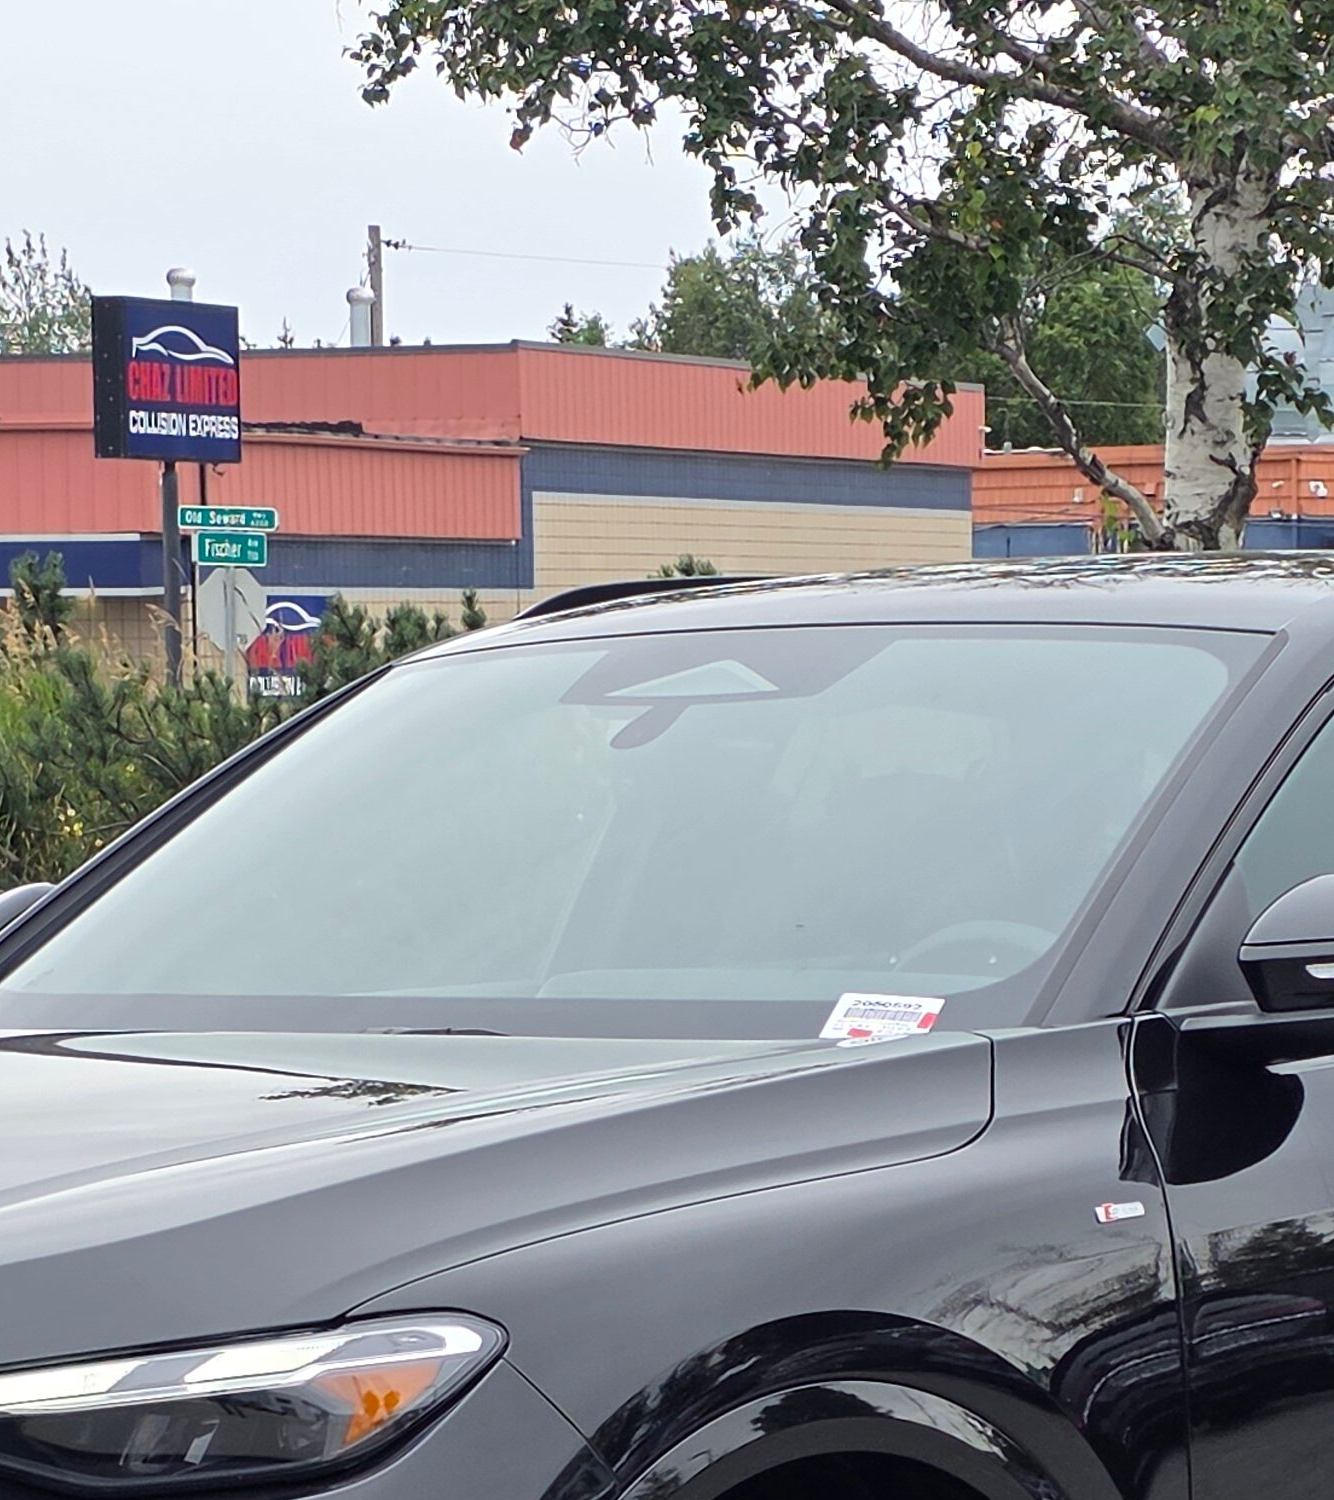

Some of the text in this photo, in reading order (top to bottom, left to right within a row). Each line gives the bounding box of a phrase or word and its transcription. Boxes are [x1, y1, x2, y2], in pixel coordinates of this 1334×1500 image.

[128, 361, 237, 406] CHAZ LIMITED
[129, 409, 239, 439] COLLISION EXPRESS
[185, 510, 202, 524] Old
[209, 510, 246, 526] Seward
[204, 538, 242, 558] Fischer
